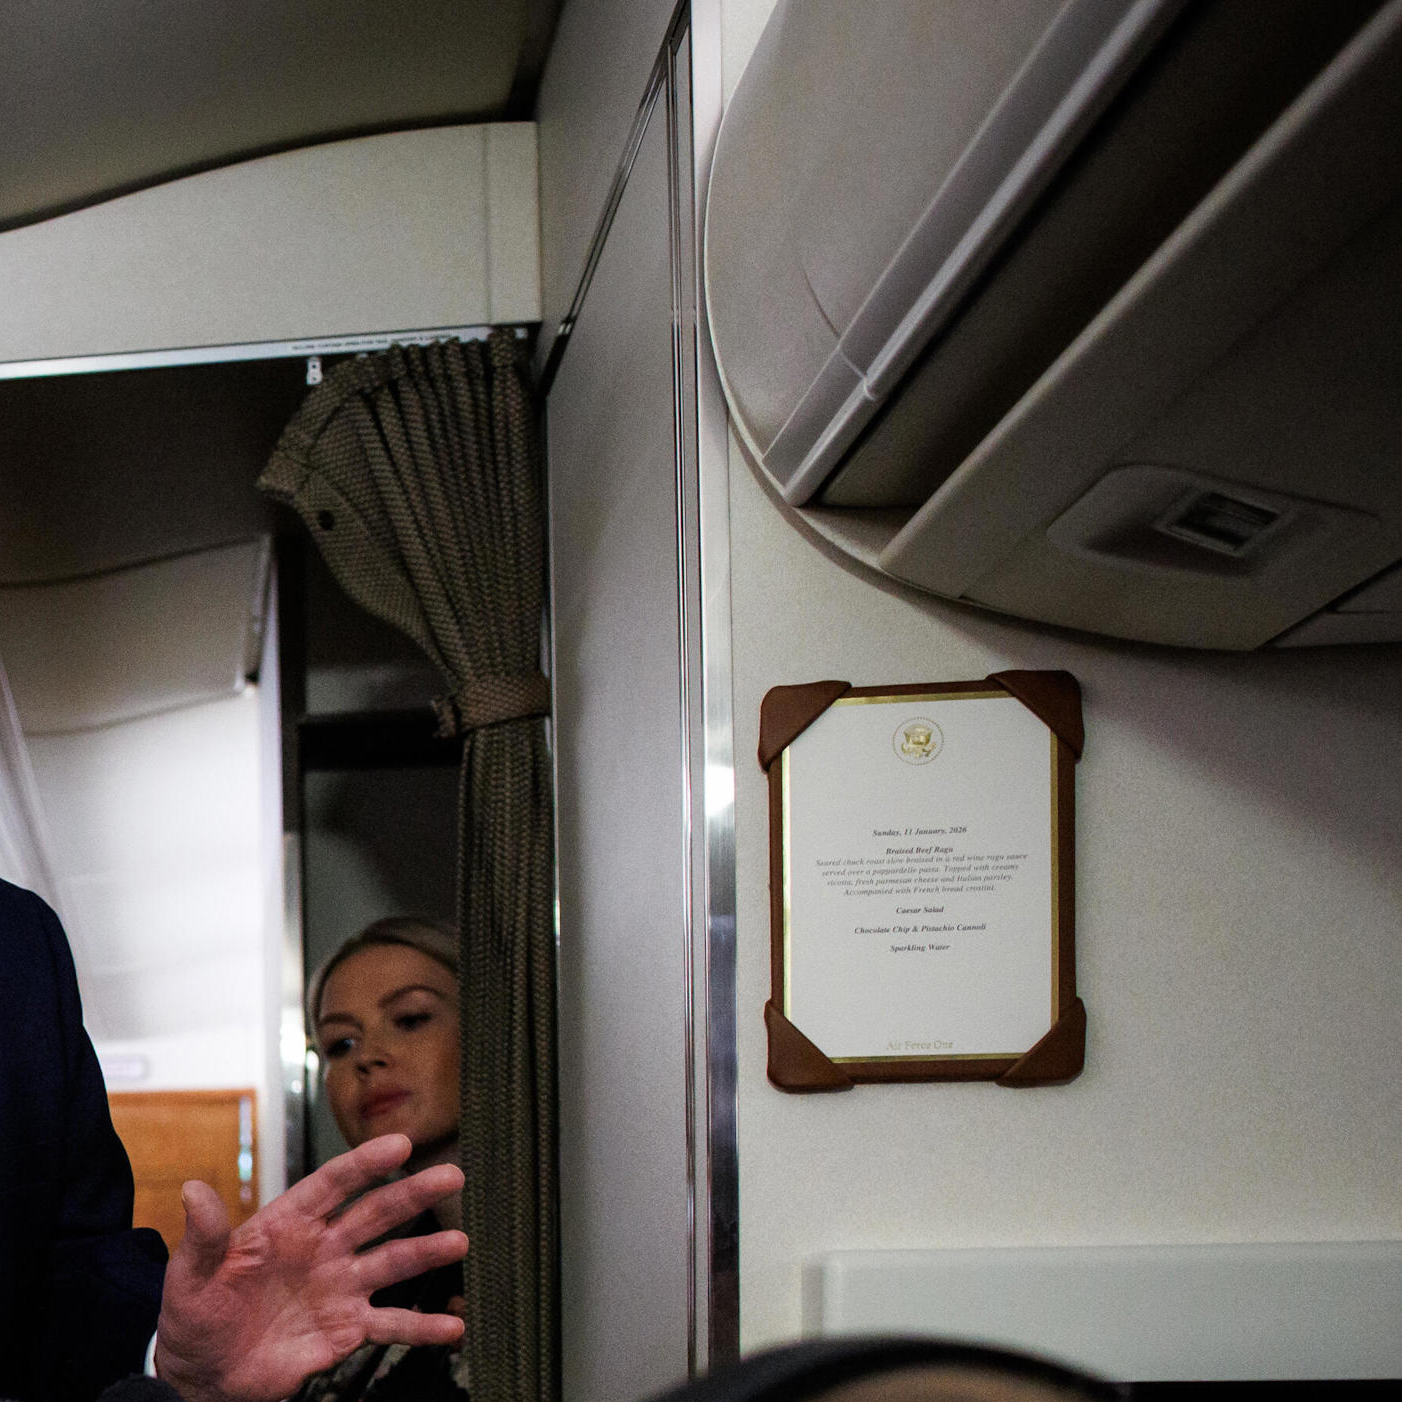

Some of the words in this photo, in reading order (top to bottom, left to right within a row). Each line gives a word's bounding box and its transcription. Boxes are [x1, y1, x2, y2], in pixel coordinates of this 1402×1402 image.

[873, 829, 901, 837] Sunday,
[915, 828, 947, 836] January,
[892, 926, 910, 934] Chip
[921, 924, 955, 932] Pistachio
[957, 923, 986, 931] Cannoli
[890, 944, 926, 953] Sparkling
[928, 943, 950, 951] Water
